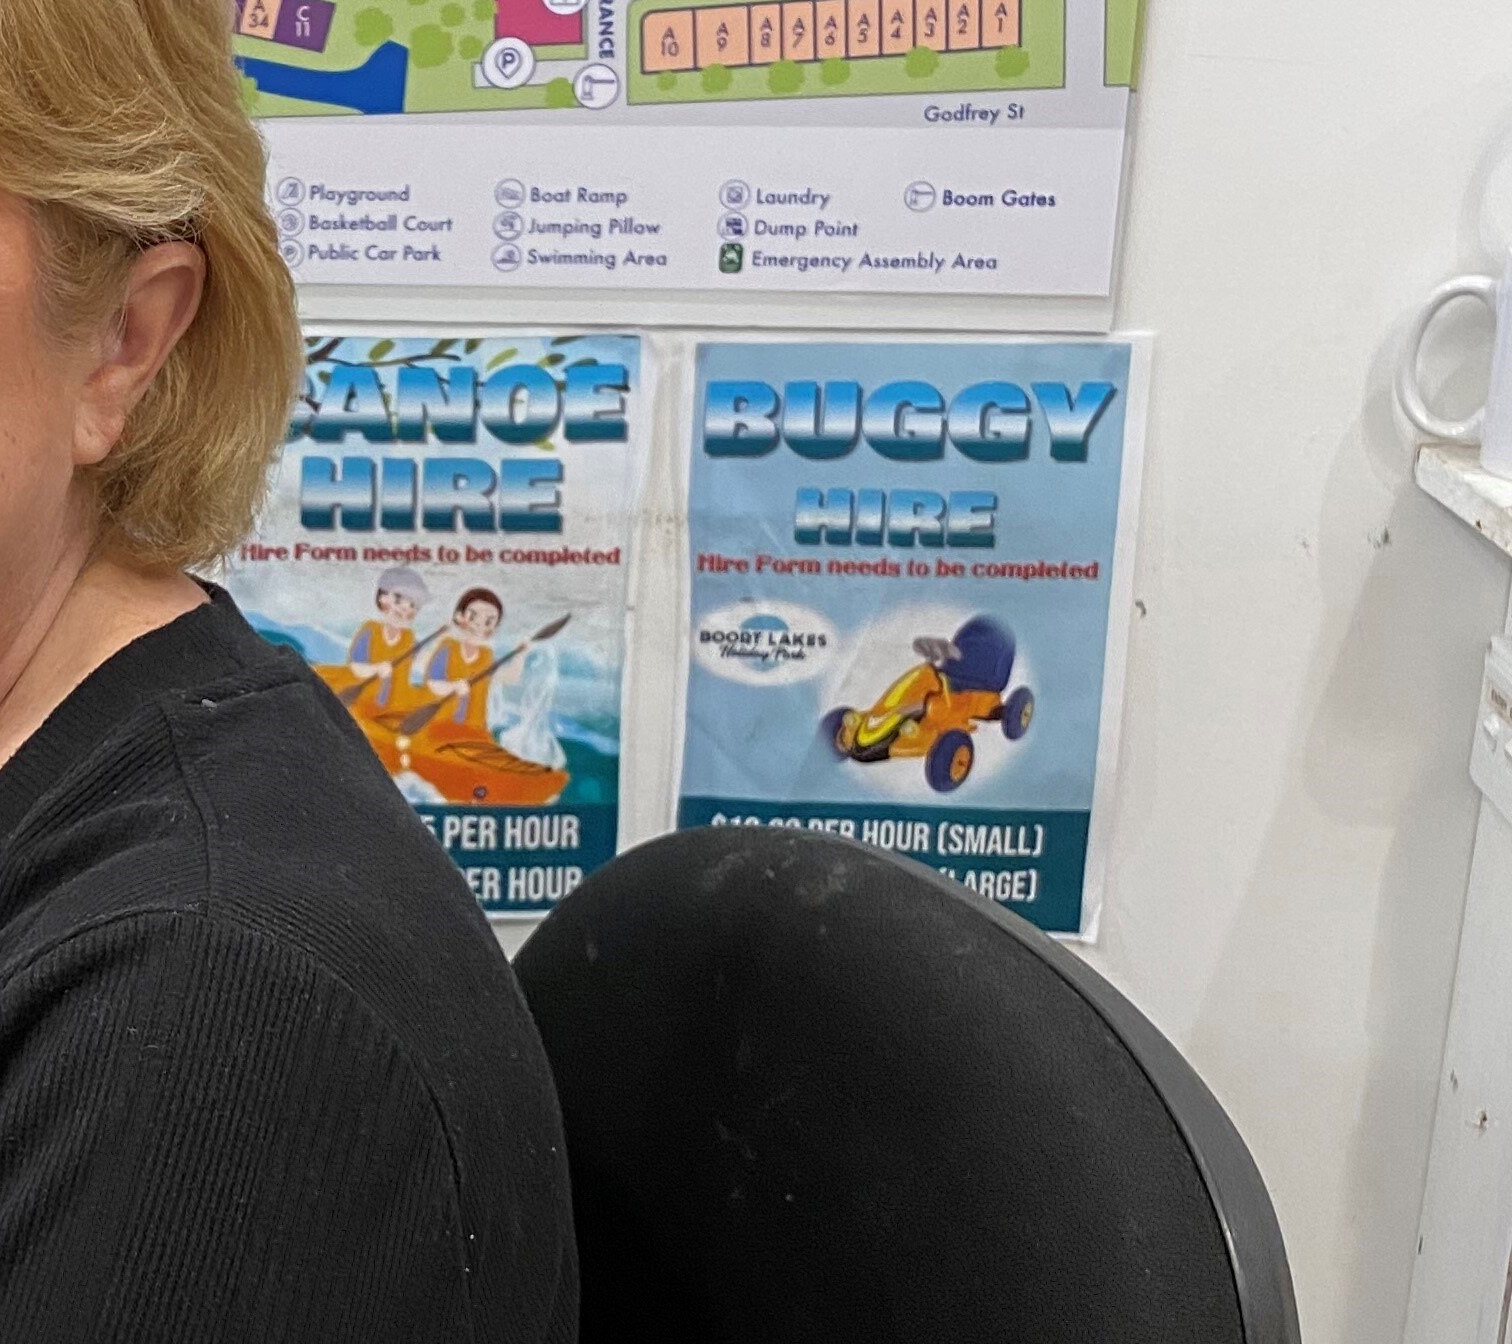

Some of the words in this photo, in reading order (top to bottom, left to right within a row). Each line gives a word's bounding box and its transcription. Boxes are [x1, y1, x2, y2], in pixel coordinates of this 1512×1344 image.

[924, 105, 999, 125] Godfrey
[1008, 104, 1025, 121] St
[309, 185, 410, 206] Playground
[530, 187, 570, 202] Boat
[577, 188, 628, 207] Ramp
[756, 188, 831, 210] Laundry
[943, 190, 993, 206] Boom
[1001, 191, 1056, 207] Gates
[309, 214, 397, 230] Basketball
[403, 216, 453, 231] Court
[528, 219, 601, 238] Jumping
[609, 219, 660, 235] Pillow
[754, 222, 806, 238] Dump
[815, 222, 858, 236] Point
[309, 246, 358, 260] Public
[365, 246, 396, 261] Car
[403, 246, 440, 261] Park
[528, 249, 615, 269] Swimming
[623, 251, 667, 265] Area
[752, 252, 852, 271] Emergency
[859, 253, 945, 272] Assembly
[952, 255, 997, 269] Area
[703, 380, 1118, 464] BUGGY
[301, 456, 563, 534] HIRE
[794, 488, 998, 549] HIRE
[241, 544, 288, 561] Hire
[294, 543, 357, 561] Form
[363, 544, 430, 562] needs
[438, 545, 459, 563] to
[466, 545, 492, 562] be
[500, 546, 620, 566] completed
[697, 553, 749, 574] Hire
[756, 556, 821, 575] Form
[828, 558, 901, 576] needs
[908, 560, 929, 576] to
[936, 561, 965, 577] be
[972, 561, 1099, 580] completed
[443, 815, 497, 850] PER
[504, 815, 580, 850] HOUR
[862, 821, 929, 851] HOUR
[937, 824, 1045, 856] (SMALL)
